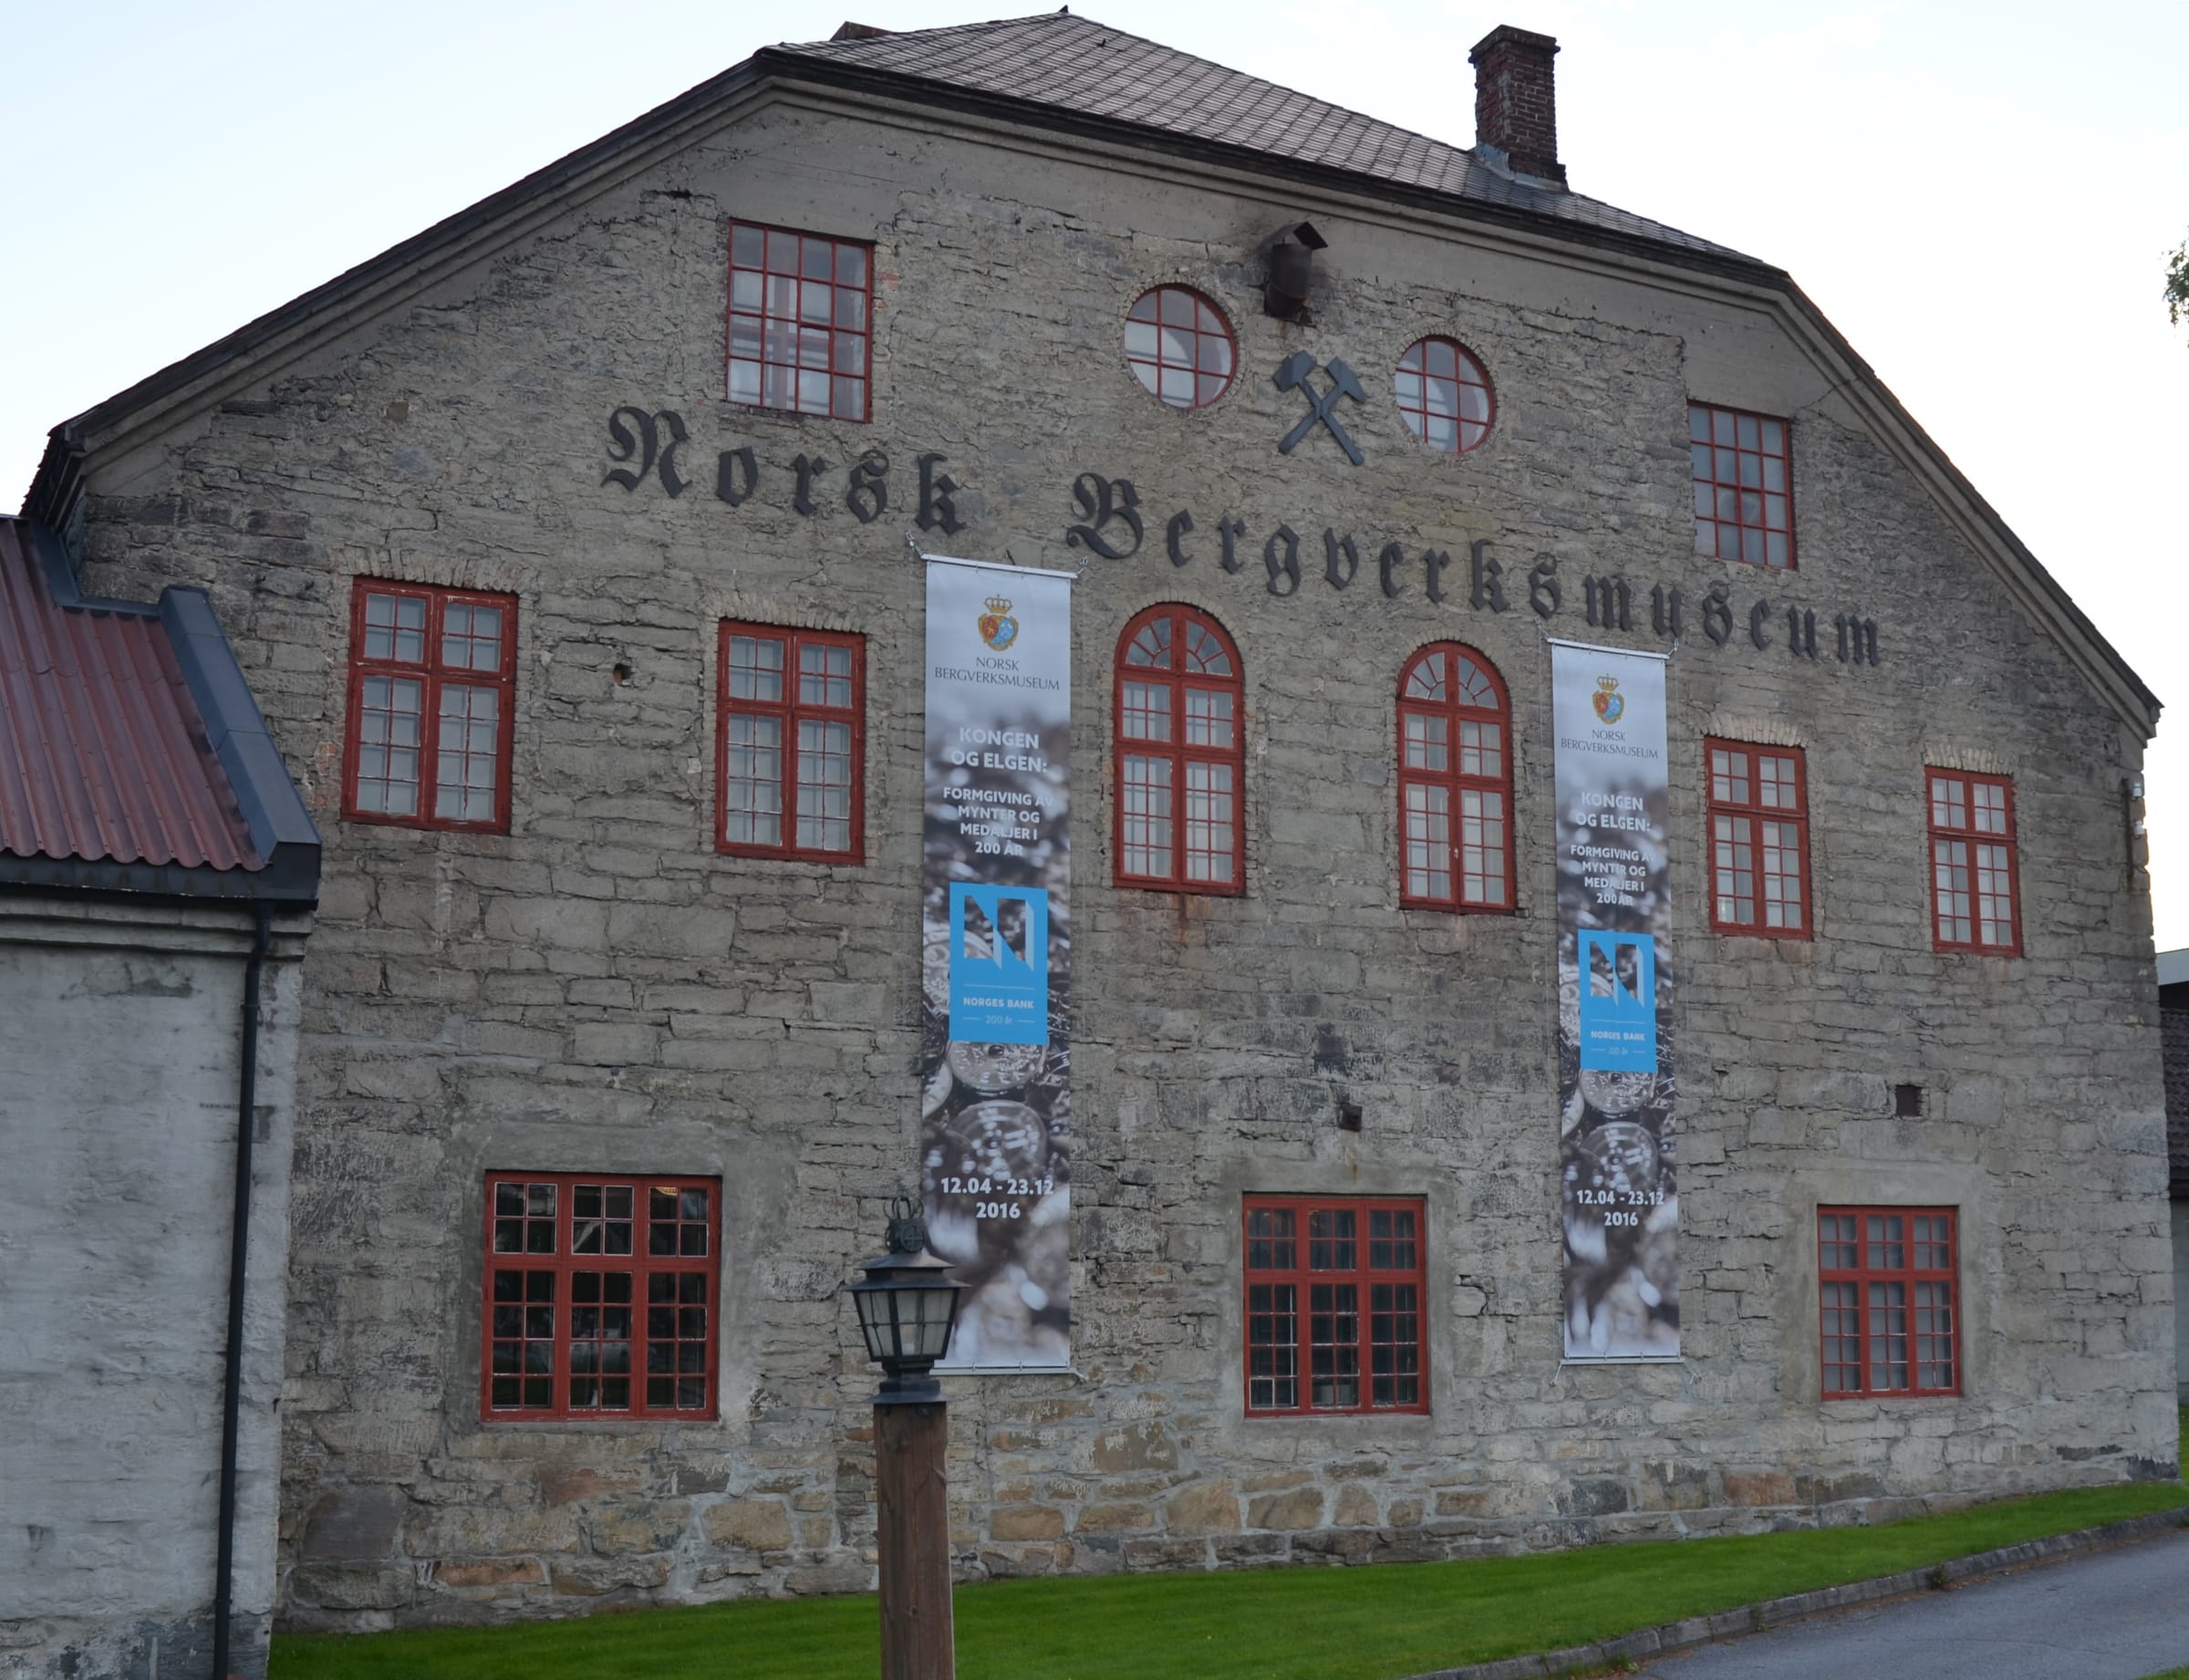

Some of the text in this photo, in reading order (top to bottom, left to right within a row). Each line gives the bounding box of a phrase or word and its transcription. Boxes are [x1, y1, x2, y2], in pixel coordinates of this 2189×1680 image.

[600, 406, 1878, 665] Norsk Bergverksmuseum
[976, 656, 1020, 671] NORSK
[935, 667, 1060, 690] BERGVERKSMUSEUM
[960, 727, 1040, 750] KONGEN
[1592, 730, 1626, 741] NORSK
[1561, 738, 1658, 759] BERGVERKSMUSEUM
[950, 751, 1048, 773] OG ELGEN:
[943, 786, 1055, 807] FORMGIVING AV
[1582, 792, 1644, 811] KONGEN
[959, 806, 1040, 823] MYNTER OG
[1575, 813, 1650, 832] OG ELGEN:
[960, 823, 1038, 840] MEDALJER I
[975, 839, 1023, 856] 200 ÅR
[1571, 845, 1656, 862] FORMGIVING AV
[1582, 861, 1646, 876] MYNTER OG
[1584, 876, 1644, 892] MEDALJER I
[1596, 891, 1634, 906] 200 ÅR
[963, 997, 1034, 1010] NORGES BANK
[986, 1014, 1003, 1024] 200
[1591, 1030, 1645, 1042] NORGES BANK
[940, 1177, 991, 1194] 12.04
[1007, 1178, 1053, 1195] 23.12
[1576, 1189, 1615, 1206] 12.04
[1628, 1191, 1665, 1207] 23.12
[976, 1202, 1021, 1219] 2016
[1603, 1211, 1638, 1227] 2016
